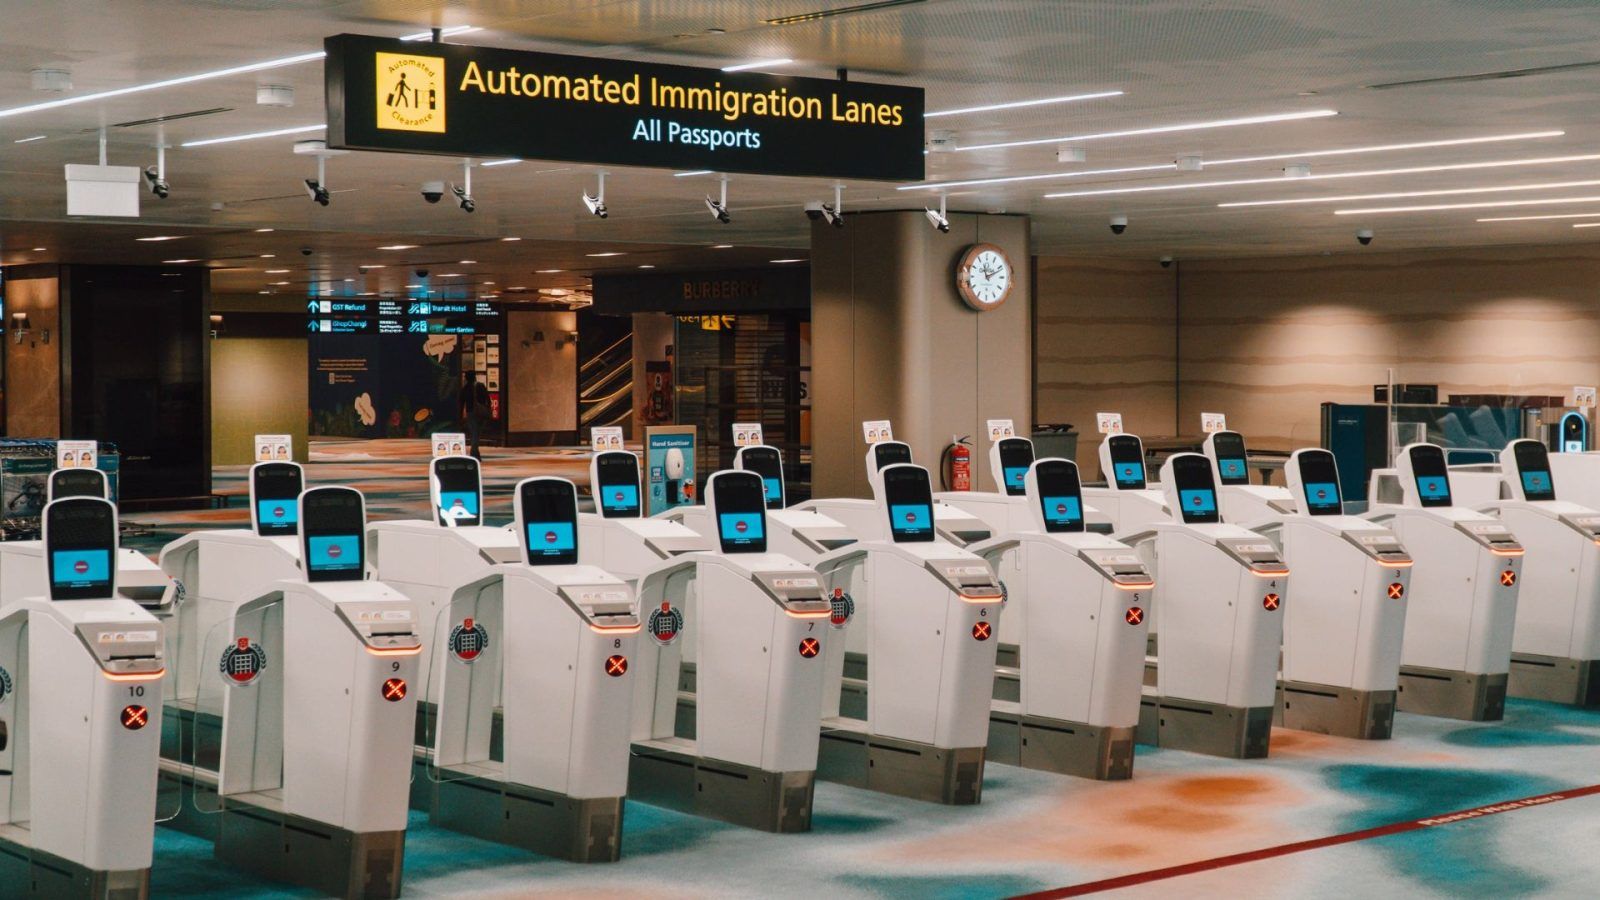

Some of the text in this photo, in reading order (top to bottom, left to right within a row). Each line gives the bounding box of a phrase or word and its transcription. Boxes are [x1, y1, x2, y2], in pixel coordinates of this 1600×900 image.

[387, 58, 436, 77] Automated
[460, 60, 903, 126] Automated Immigration Lanes
[391, 109, 434, 126] Clearance
[633, 119, 761, 150] All Passports
[683, 280, 760, 299] BURBERRY
[1396, 570, 1401, 578] 3
[1133, 593, 1139, 602] 5
[980, 608, 987, 617] 6
[807, 622, 814, 632] 7
[614, 638, 621, 649] 8
[392, 661, 399, 672] 9
[128, 685, 145, 697] 10
